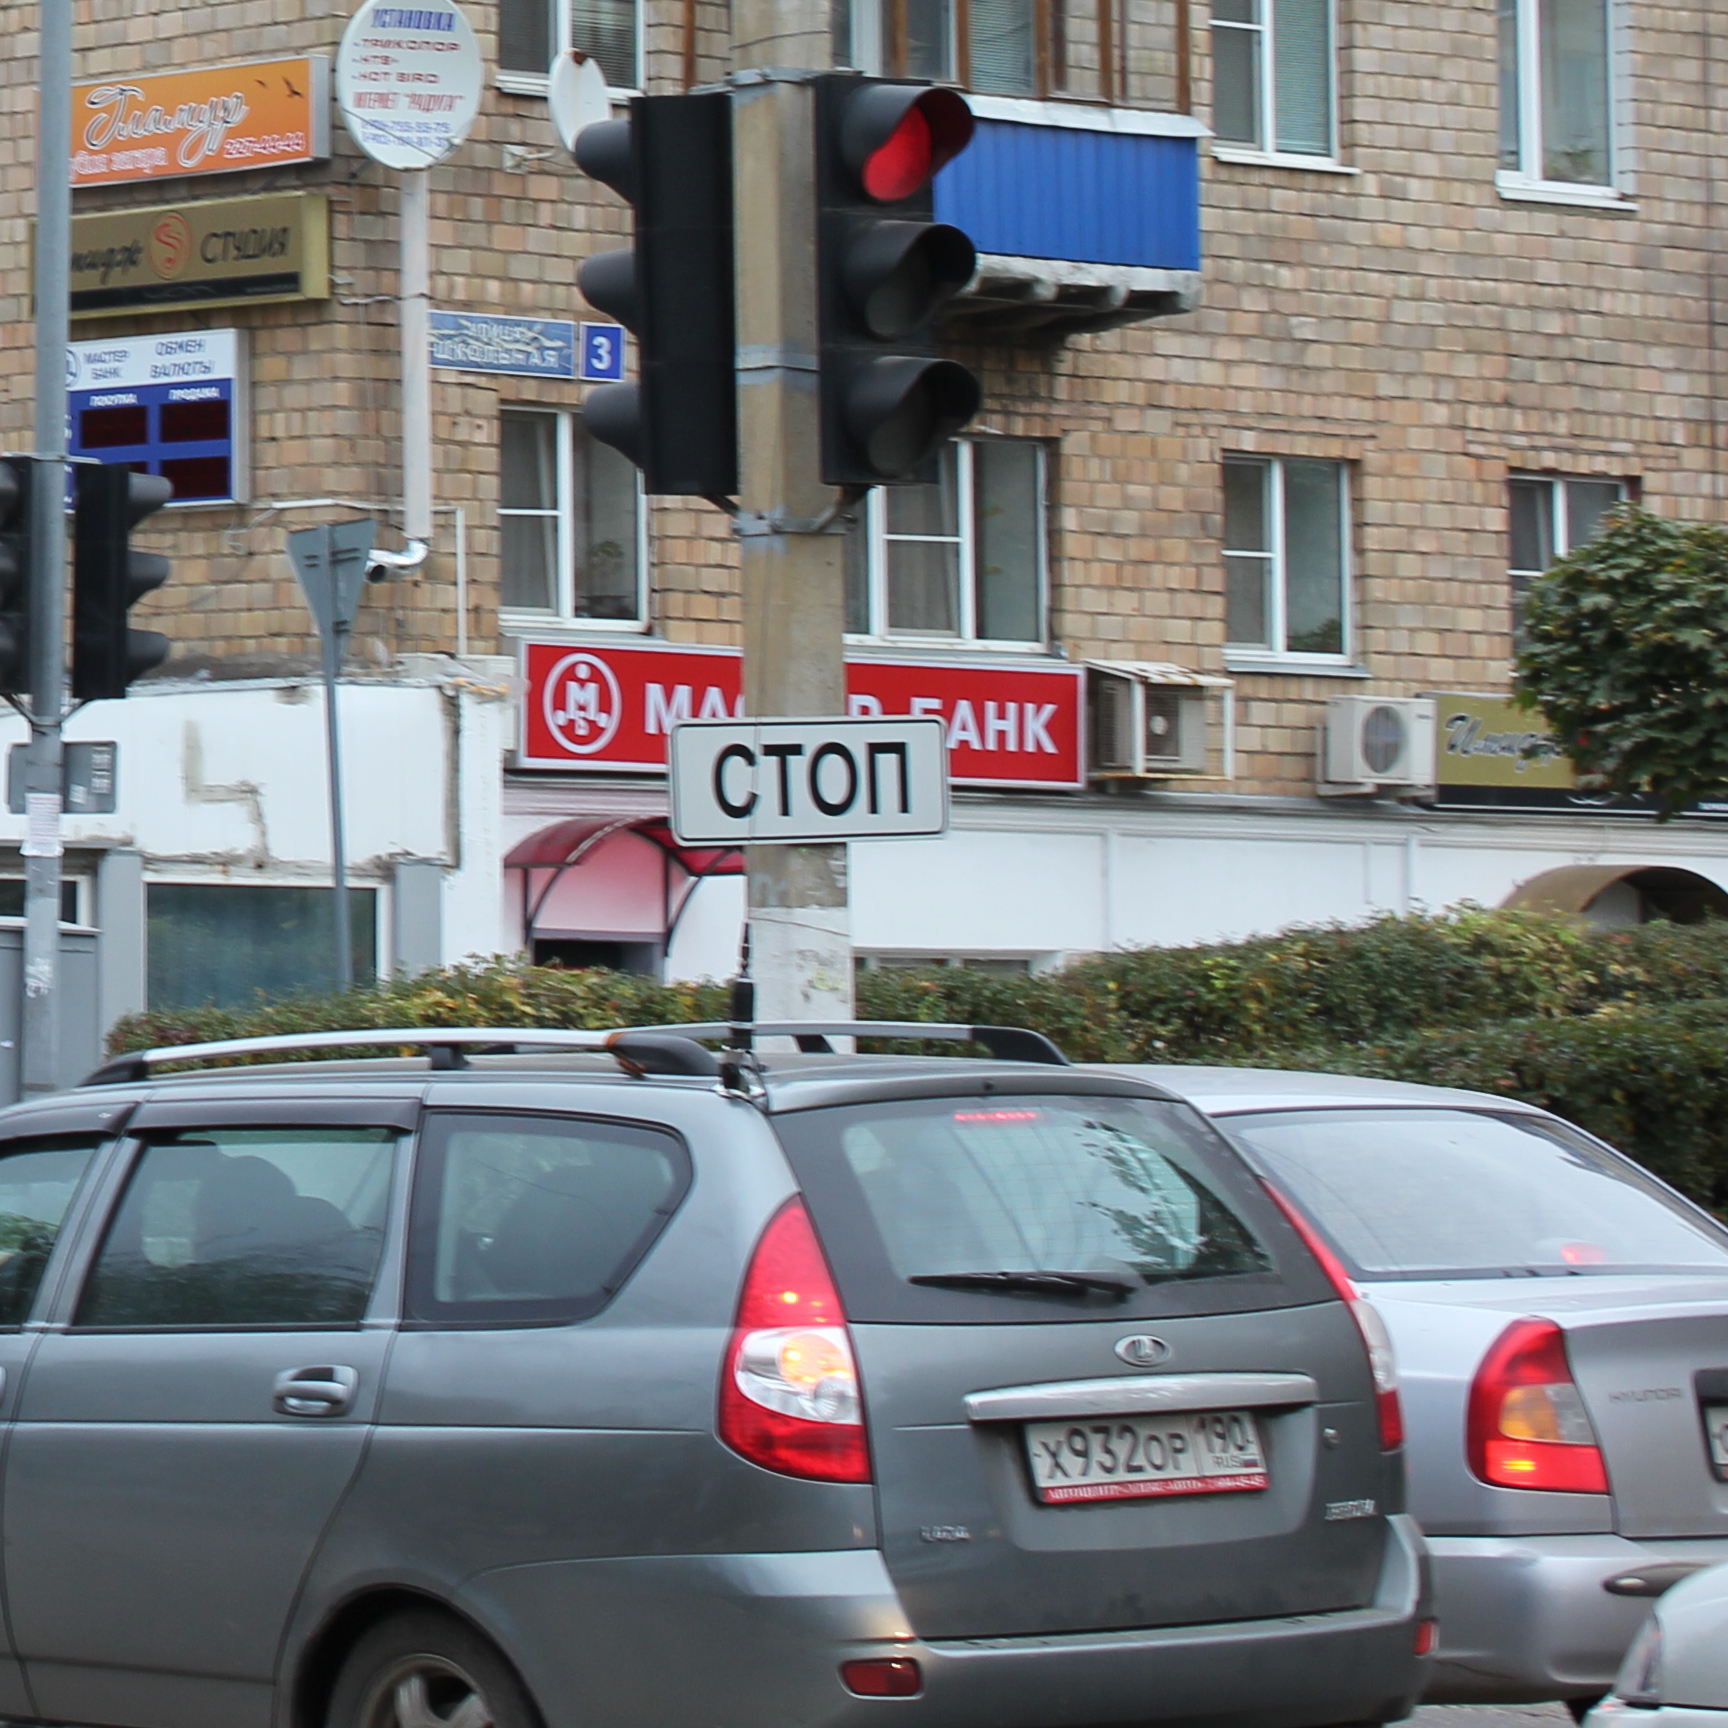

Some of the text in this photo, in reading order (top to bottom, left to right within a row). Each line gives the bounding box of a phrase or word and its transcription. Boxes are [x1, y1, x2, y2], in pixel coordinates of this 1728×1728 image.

[372, 9, 455, 32] УСТАНОВКА
[396, 73, 440, 84] BIRD
[85, 84, 250, 167] Гламур
[200, 226, 291, 263] СТУДИЯ
[155, 339, 206, 357] ОБМЕН
[590, 336, 612, 370] 3
[149, 360, 215, 379] ВАЛЮТЫ
[712, 741, 909, 819] СТОП
[1195, 1414, 1248, 1453] 190
[1212, 1454, 1243, 1468] RUS
